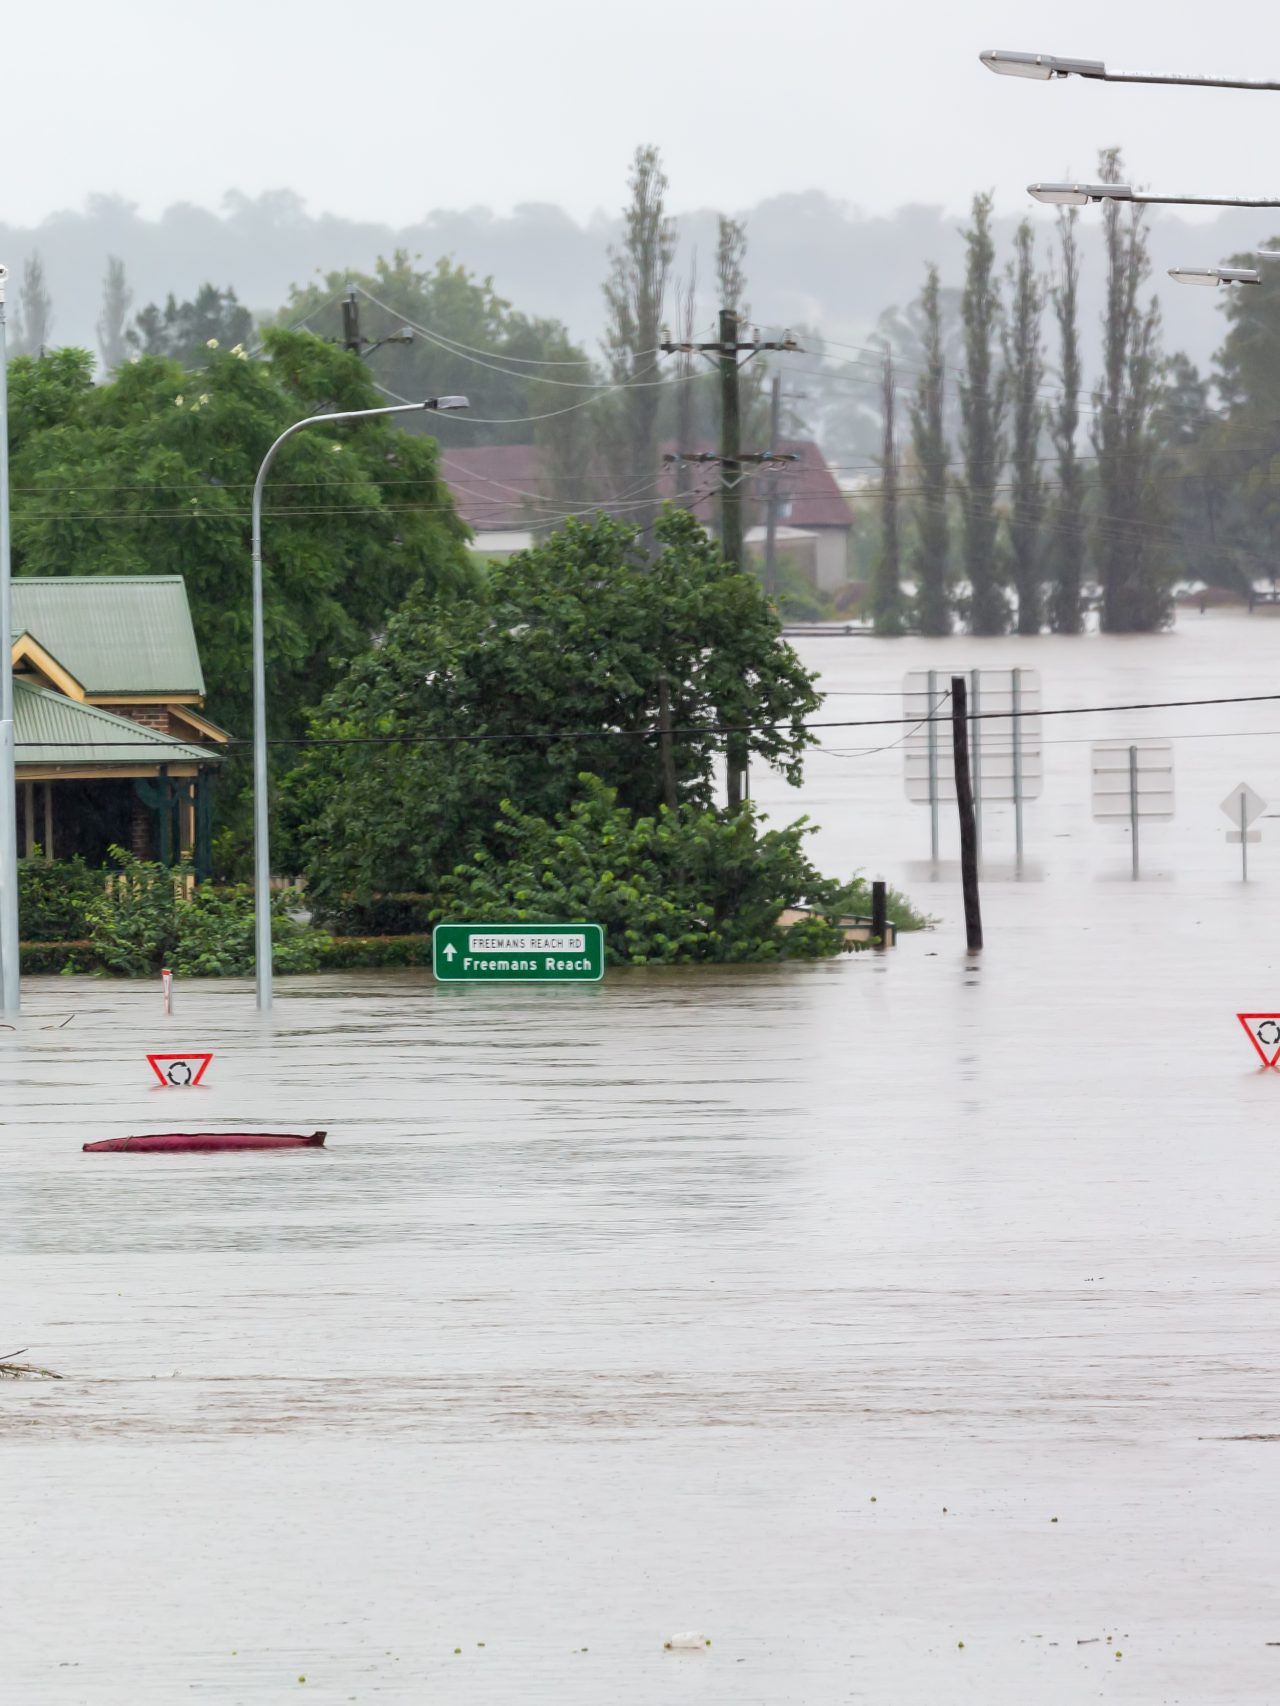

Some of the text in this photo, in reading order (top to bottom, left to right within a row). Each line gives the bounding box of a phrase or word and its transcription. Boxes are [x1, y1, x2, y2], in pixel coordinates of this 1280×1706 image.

[472, 938, 582, 949] FREEMANS REACH RD
[463, 957, 592, 971] Freemans Reach
